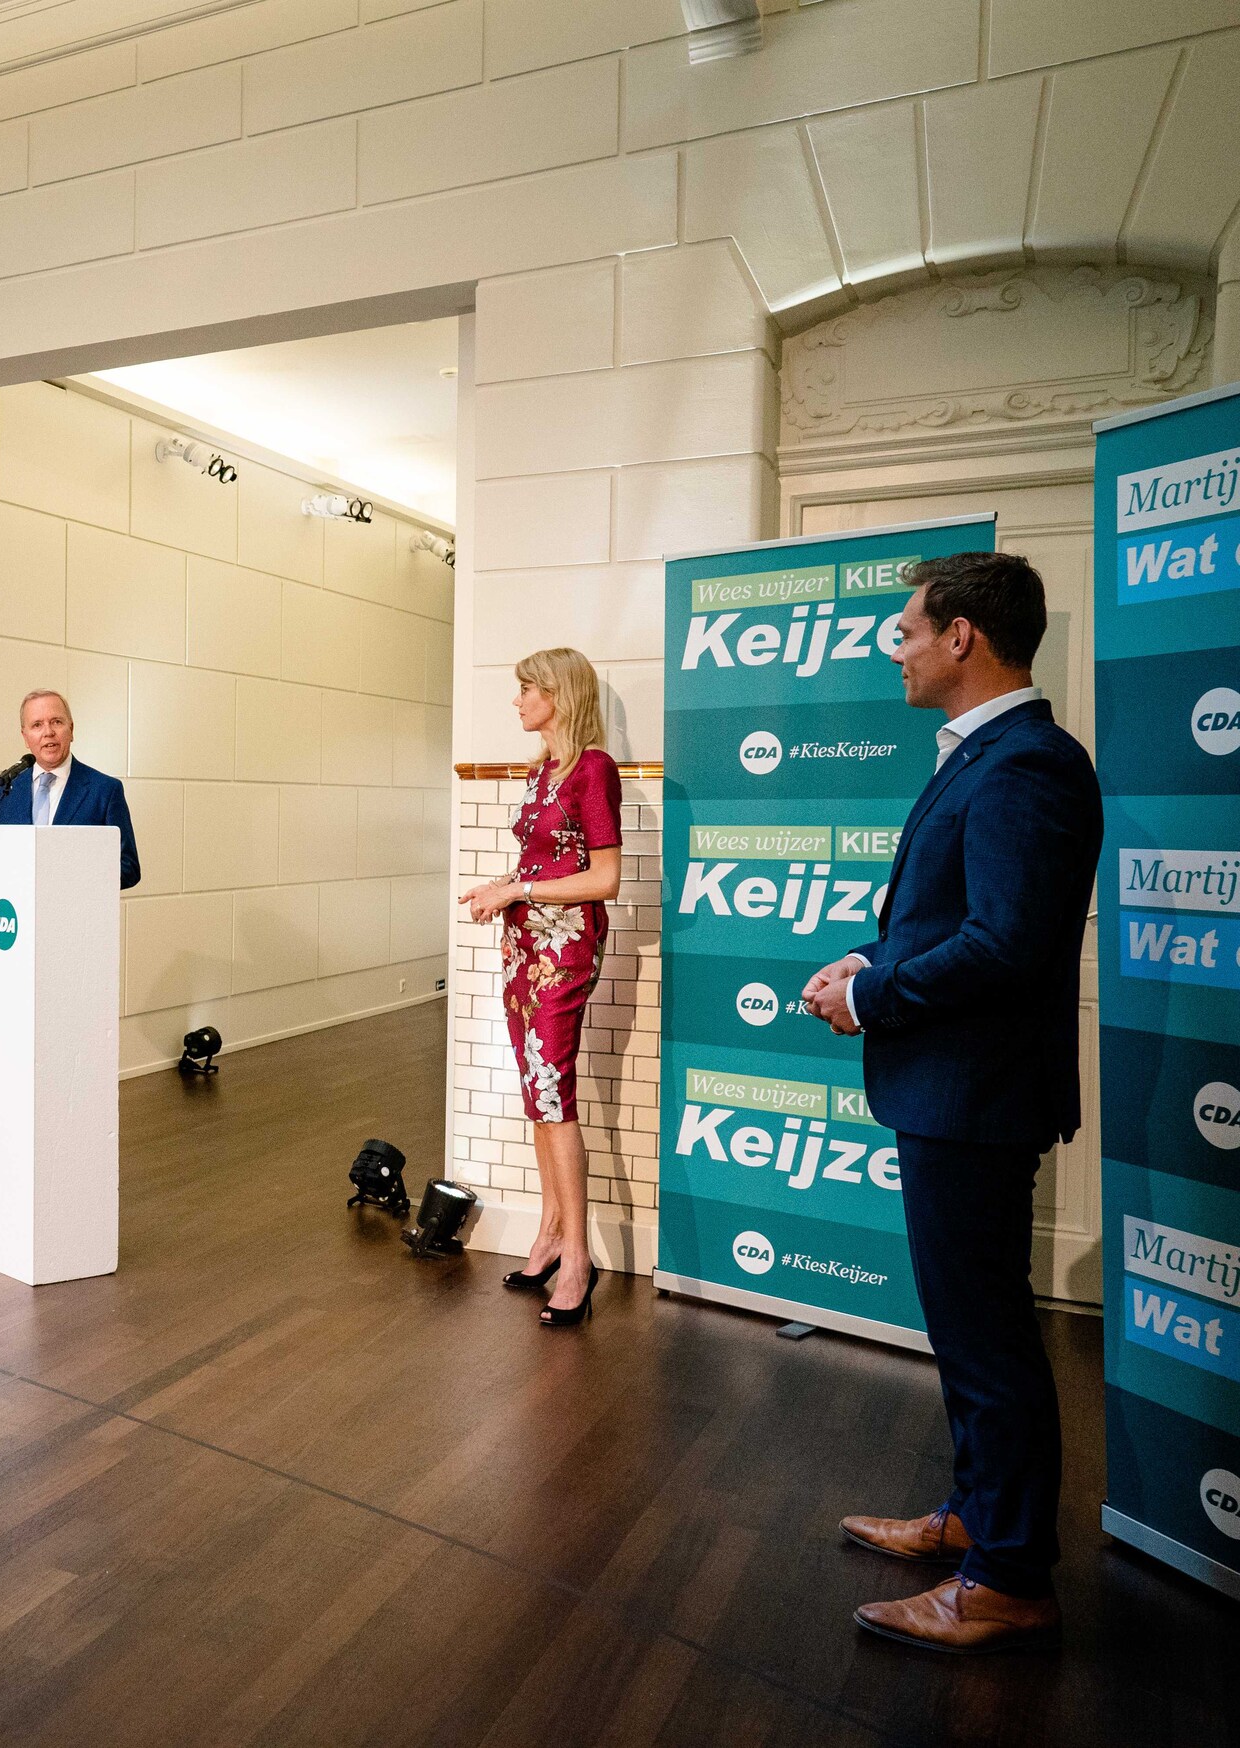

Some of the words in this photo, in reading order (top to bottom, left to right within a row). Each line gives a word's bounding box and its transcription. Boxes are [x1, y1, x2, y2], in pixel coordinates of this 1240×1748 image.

[1124, 456, 1240, 516] Martij
[1126, 531, 1219, 586] Wat
[697, 584, 752, 604] Wees
[759, 574, 830, 600] wijzer
[681, 602, 903, 678] Keijze
[743, 746, 778, 760] CDA
[789, 740, 897, 761] #KiesKeijzer
[695, 831, 749, 852] Wees
[755, 831, 826, 856] wijzer
[678, 862, 889, 935] Keijz
[1126, 858, 1240, 906] Martij
[1129, 921, 1219, 968] Wat
[740, 997, 774, 1012] CDA
[692, 1074, 745, 1099] Wees
[752, 1084, 821, 1109] wijzer
[837, 1092, 873, 1118] KI
[675, 1104, 903, 1191] Keijze
[737, 1244, 770, 1262] CDA
[781, 1253, 888, 1286] #KiesKeijzer
[1130, 1228, 1240, 1298] Martij
[1133, 1288, 1223, 1356] Wat
[1206, 1489, 1240, 1517] CD
